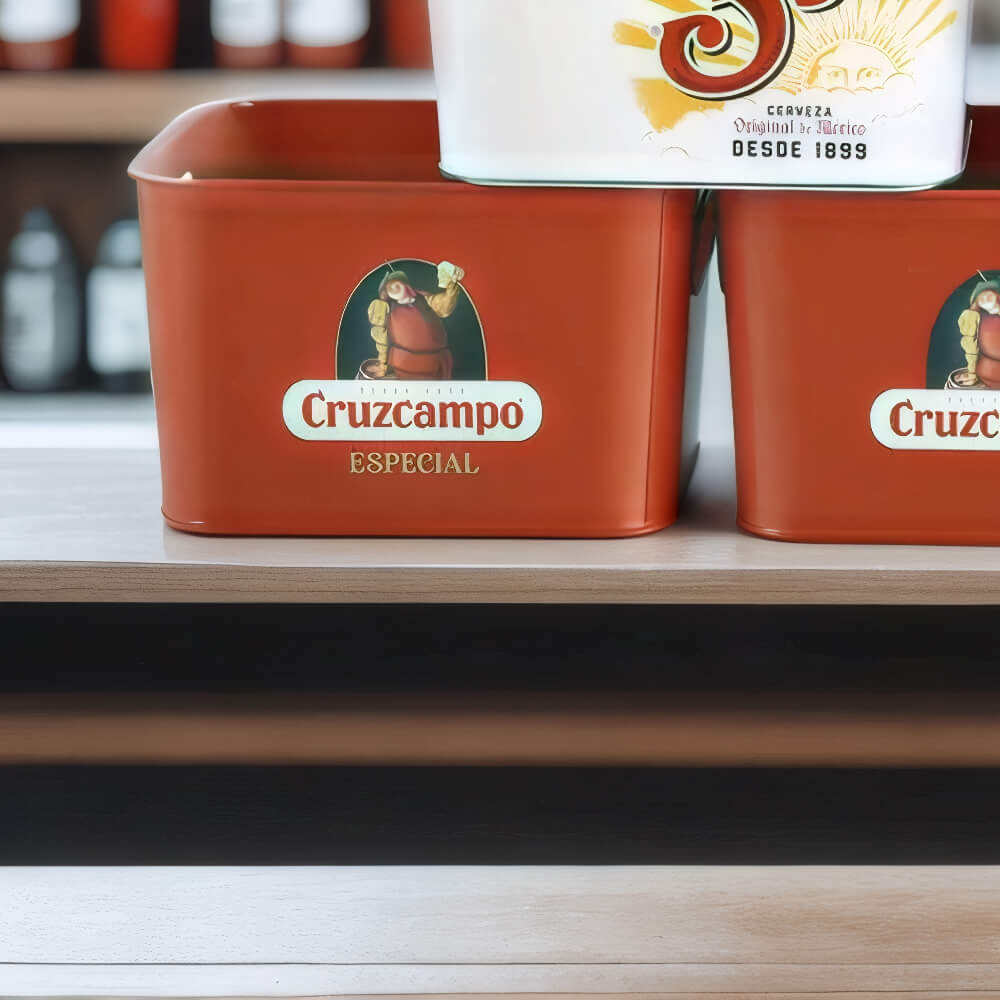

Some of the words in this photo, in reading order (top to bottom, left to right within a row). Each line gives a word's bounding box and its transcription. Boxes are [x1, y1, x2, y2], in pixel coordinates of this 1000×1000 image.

[767, 105, 832, 118] CERVEZA
[732, 140, 802, 158] DESDE
[816, 142, 867, 160] 1899
[301, 388, 524, 435] Cruzcampo
[349, 452, 480, 474] ESPECIAL
